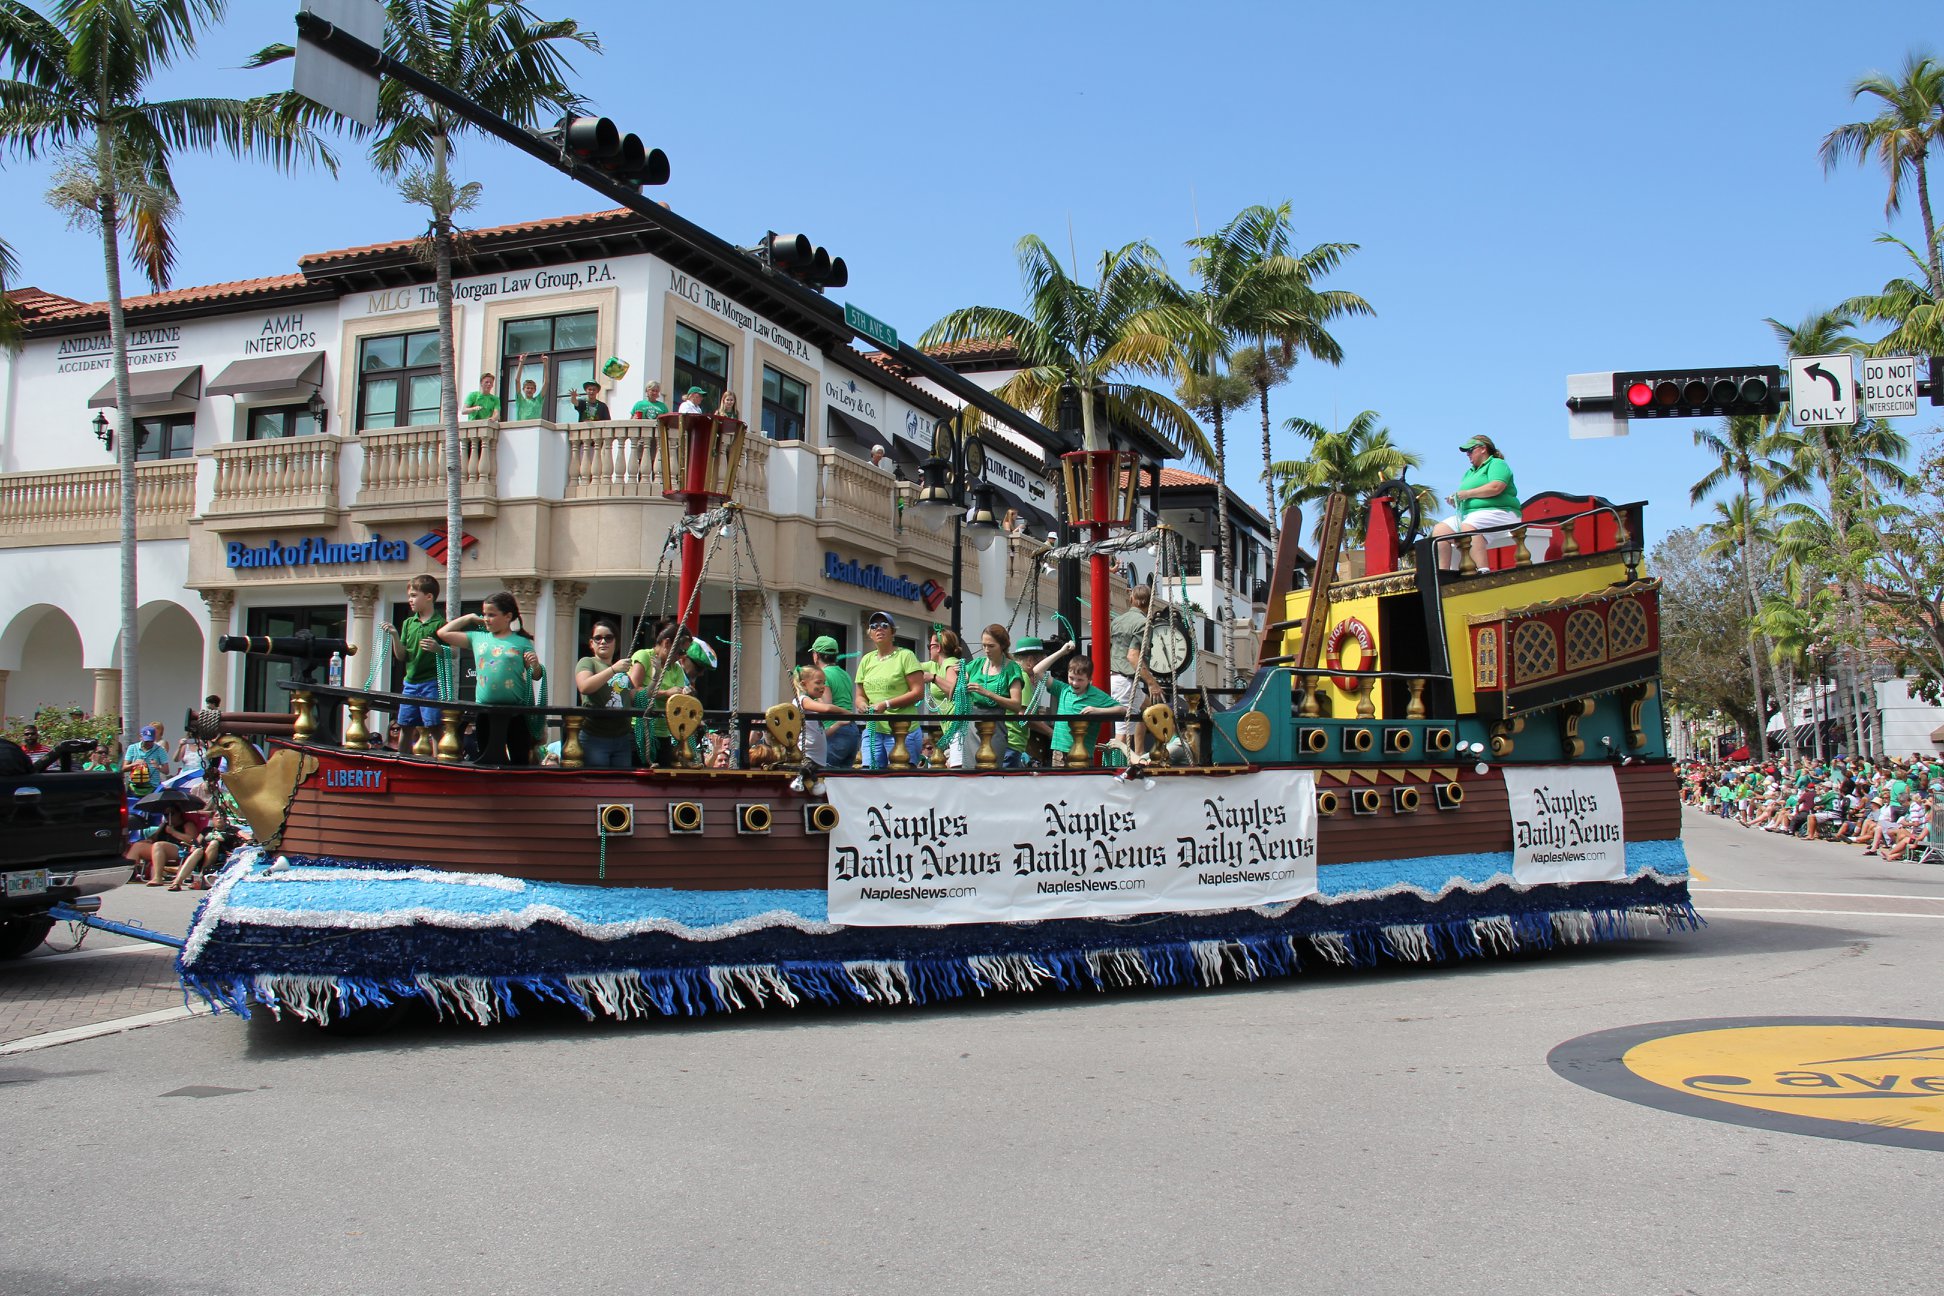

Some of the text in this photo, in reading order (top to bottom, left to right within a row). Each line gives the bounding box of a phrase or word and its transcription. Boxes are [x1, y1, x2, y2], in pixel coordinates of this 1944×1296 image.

[367, 289, 411, 313] MLG
[450, 282, 497, 301] Morgan
[501, 276, 531, 293] Law
[535, 271, 582, 290] Group,
[587, 263, 616, 283] P.A.
[261, 313, 303, 335] AMH
[670, 269, 811, 361] MLG The Morgan Law Group, P.A.
[851, 309, 892, 344] 5TH AVE S
[130, 327, 180, 346] LEVINE
[245, 332, 316, 354] INTERIORS
[58, 351, 177, 374] ACCIDENT TORNEYS
[1867, 365, 1912, 380] DO NOT
[825, 382, 877, 419] Ovi Levy & Co.
[1867, 384, 1914, 399] BLOCK
[1800, 407, 1846, 421] ONLY
[1867, 401, 1914, 412] INTERSECTION
[985, 456, 1007, 480] CUTIVE
[226, 533, 409, 569] Bank of America
[825, 552, 920, 602] Bank of America
[326, 769, 383, 789] LIBERTY
[1203, 795, 1287, 834] Naples
[1533, 786, 1597, 819] Naples
[867, 802, 969, 847] Naples
[1044, 800, 1136, 841] Naples
[1516, 815, 1620, 849] Daily News
[835, 840, 1001, 883] Daily News
[1013, 836, 1167, 877] Daily News
[1176, 829, 1314, 869] Daily News
[1530, 851, 1606, 865] NaplesNews.com
[1037, 878, 1146, 895] NaplesNews.com
[1198, 869, 1295, 886] NaplesNews.com
[860, 885, 977, 901] NaplesNews.com
